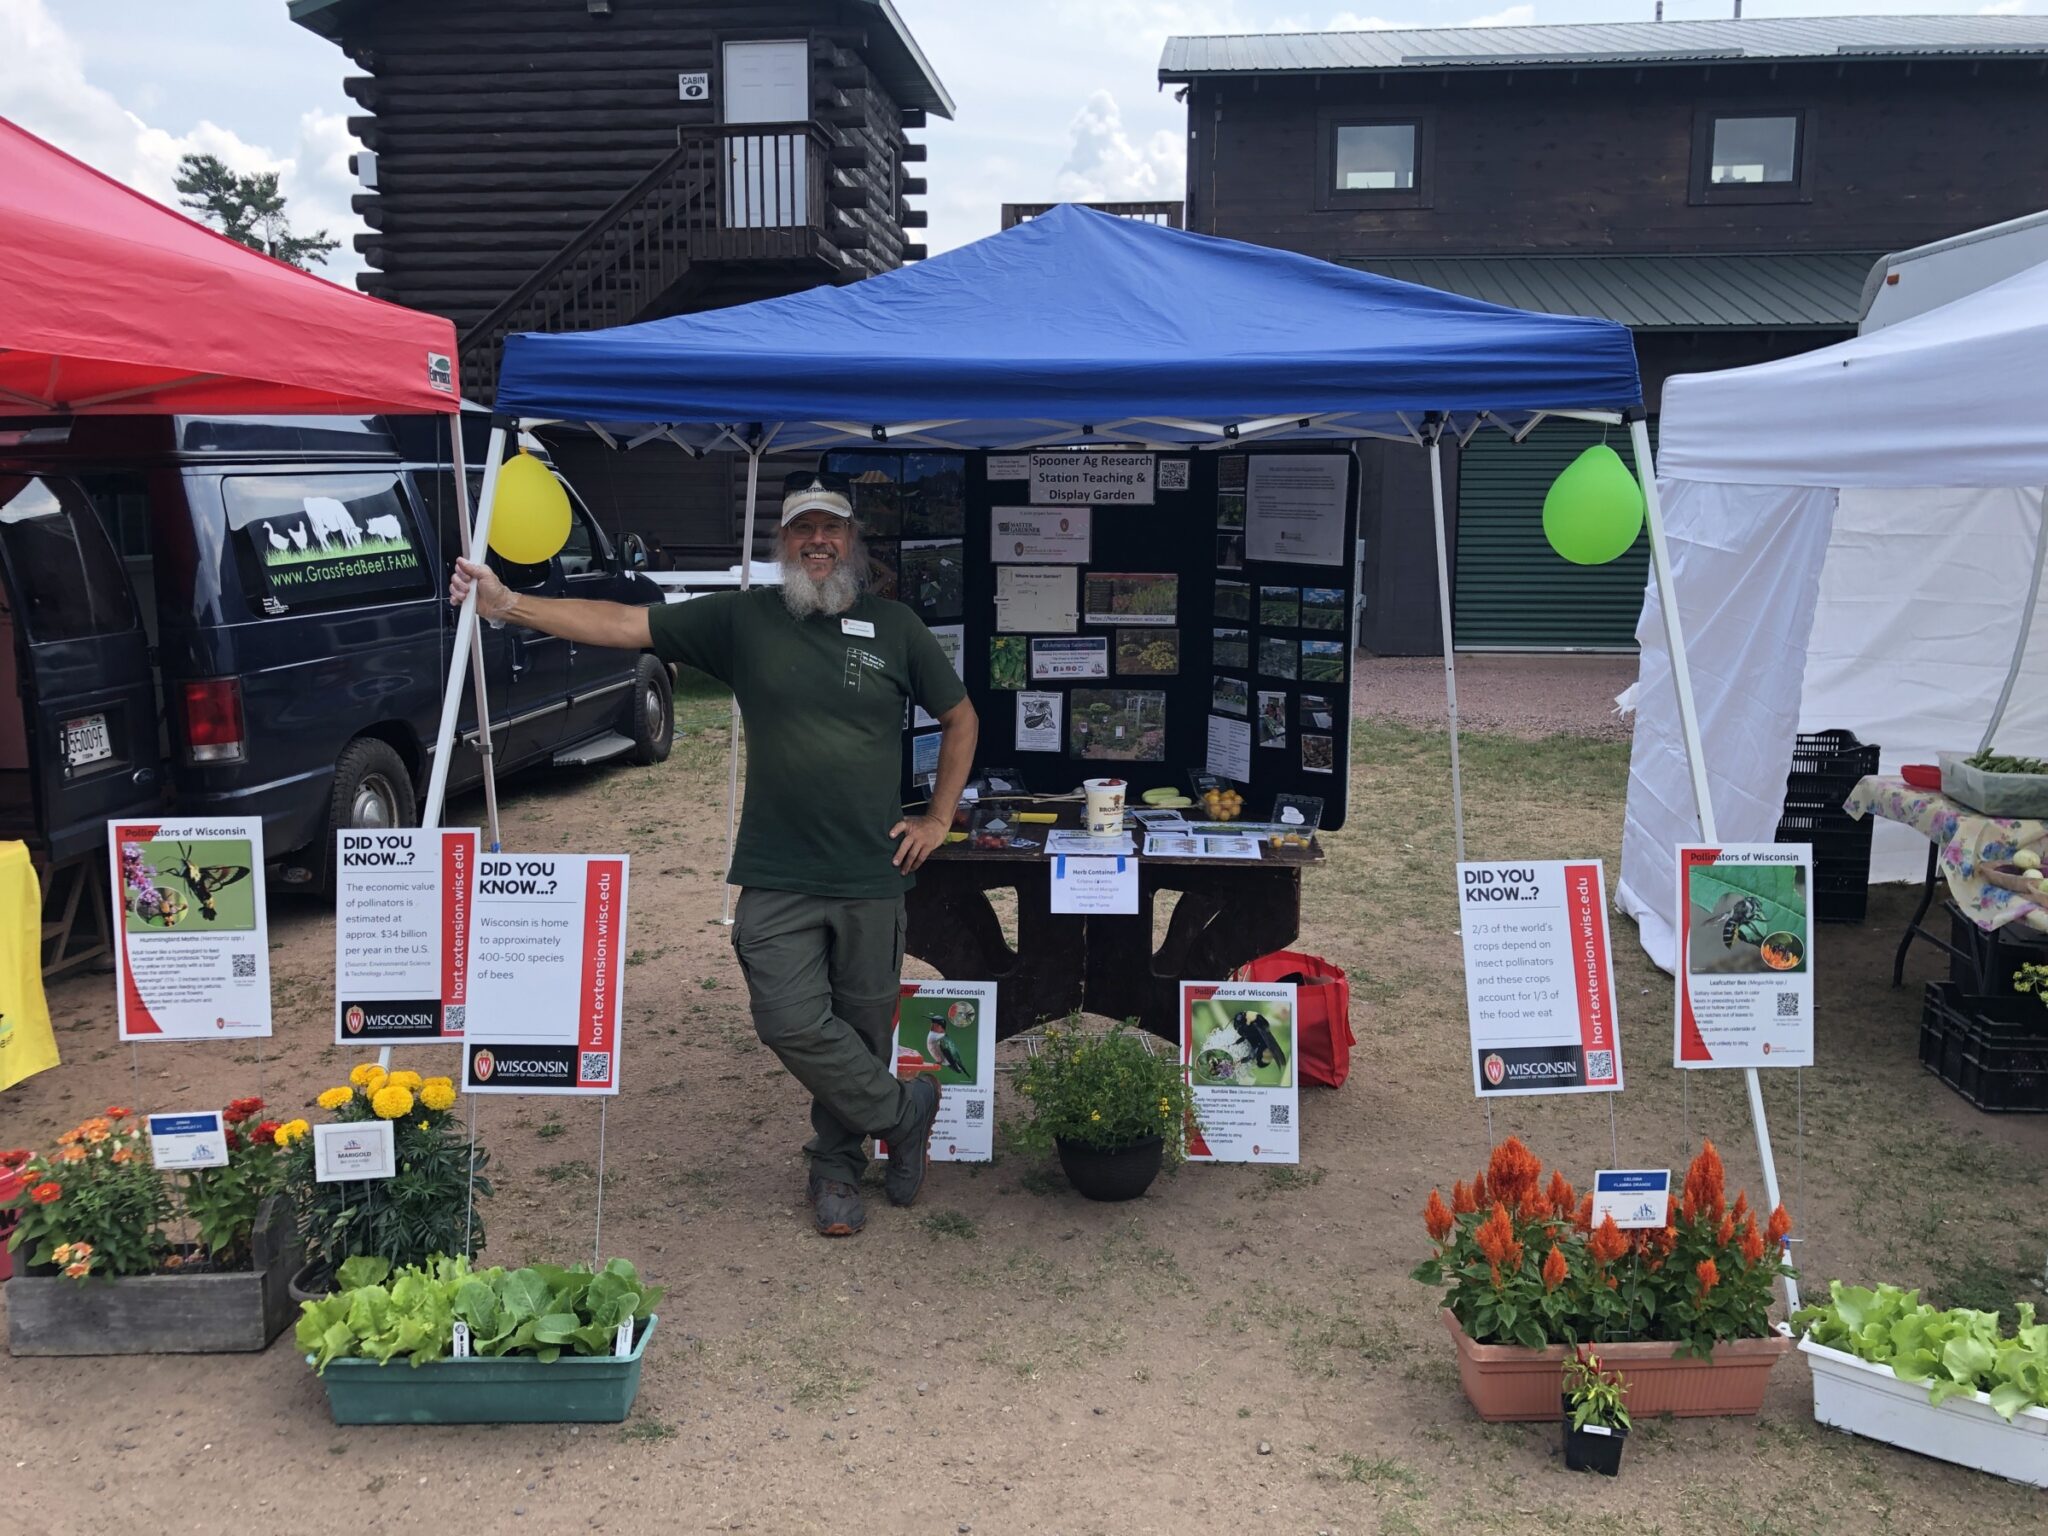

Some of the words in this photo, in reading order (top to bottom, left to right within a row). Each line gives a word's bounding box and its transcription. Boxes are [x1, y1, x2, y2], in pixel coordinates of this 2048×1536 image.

[681, 76, 705, 85] CABIN
[691, 86, 697, 96] 1
[1032, 455, 1081, 468] Spooner
[1082, 455, 1098, 468] Ag
[1101, 455, 1153, 466] Research
[1038, 472, 1079, 483] Station
[1082, 472, 1133, 485] Teaching
[1136, 472, 1146, 482] &
[1048, 489, 1090, 502] Display
[1093, 489, 1135, 500] Garden
[269, 553, 419, 588] www.GrassFedBeef.FARM
[125, 828, 181, 837] Pollinators
[182, 827, 193, 836] of
[195, 826, 247, 837] Wisconsin
[343, 836, 373, 850] DID
[375, 836, 412, 849] YOU
[343, 852, 416, 866] KNOW...?
[1690, 852, 1740, 862] Pollinators
[1740, 852, 1751, 862] of
[1753, 852, 1799, 862] Wisconsin
[480, 862, 512, 876] DID
[515, 862, 555, 877] YOU
[1464, 870, 1494, 885] DID
[1497, 868, 1535, 883] YOU
[346, 883, 364, 893] The
[365, 883, 409, 892] economic
[411, 883, 435, 891] value
[479, 880, 558, 895] KNOW...?
[1465, 885, 1539, 902] KNOW...?
[345, 898, 355, 908] of
[357, 898, 404, 909] pollinators
[405, 898, 414, 907] is
[345, 914, 391, 924] estimated
[392, 914, 402, 923] at
[451, 844, 465, 999] hort.extension.wisc.edu
[480, 917, 530, 928] Wisconsin
[531, 917, 540, 928] is
[541, 917, 569, 928] home
[380, 929, 399, 939] $34
[400, 929, 428, 938] billion
[1471, 923, 1489, 936] 2/3
[1491, 923, 1502, 934] of
[1502, 922, 1518, 933] the
[1519, 922, 1553, 933] world's
[479, 936, 490, 945] to
[492, 935, 561, 947] approximately
[1473, 941, 1500, 952] crops
[1501, 939, 1537, 952] depend
[1539, 940, 1551, 949] on
[345, 946, 360, 956] per
[362, 946, 382, 956] year
[384, 945, 393, 954] in
[394, 945, 410, 954] the
[411, 944, 430, 954] U.S.
[478, 952, 526, 963] 400-500
[527, 953, 565, 964] species
[589, 872, 611, 1046] hort.extension.wisc.edu
[1474, 958, 1504, 968] insect
[1505, 956, 1554, 969] pollinators
[1576, 877, 1603, 1045] hort.extension.wisc.edu
[477, 969, 488, 979] of
[489, 969, 515, 980] bees
[1476, 975, 1494, 985] and
[1496, 974, 1523, 984] these
[1524, 974, 1551, 985] crops
[936, 987, 945, 995] of
[946, 988, 986, 996] Wisconsin
[1194, 988, 1237, 996] Pollinators
[1237, 988, 1246, 996] of
[1247, 988, 1288, 997] Wisconsin
[1477, 991, 1516, 1002] account
[1517, 990, 1532, 1002] for
[1533, 990, 1548, 1001] 1/3
[1548, 990, 1559, 1000] of
[365, 1013, 433, 1026] WISCONSIN
[1479, 1009, 1495, 1020] the
[1497, 1008, 1521, 1019] food
[1521, 1010, 1535, 1018] we
[1537, 1008, 1553, 1017] eat
[495, 1060, 569, 1074] WISCONSIN
[1505, 1060, 1577, 1076] WISCONSIN
[337, 1151, 372, 1159] MARIGOLD
